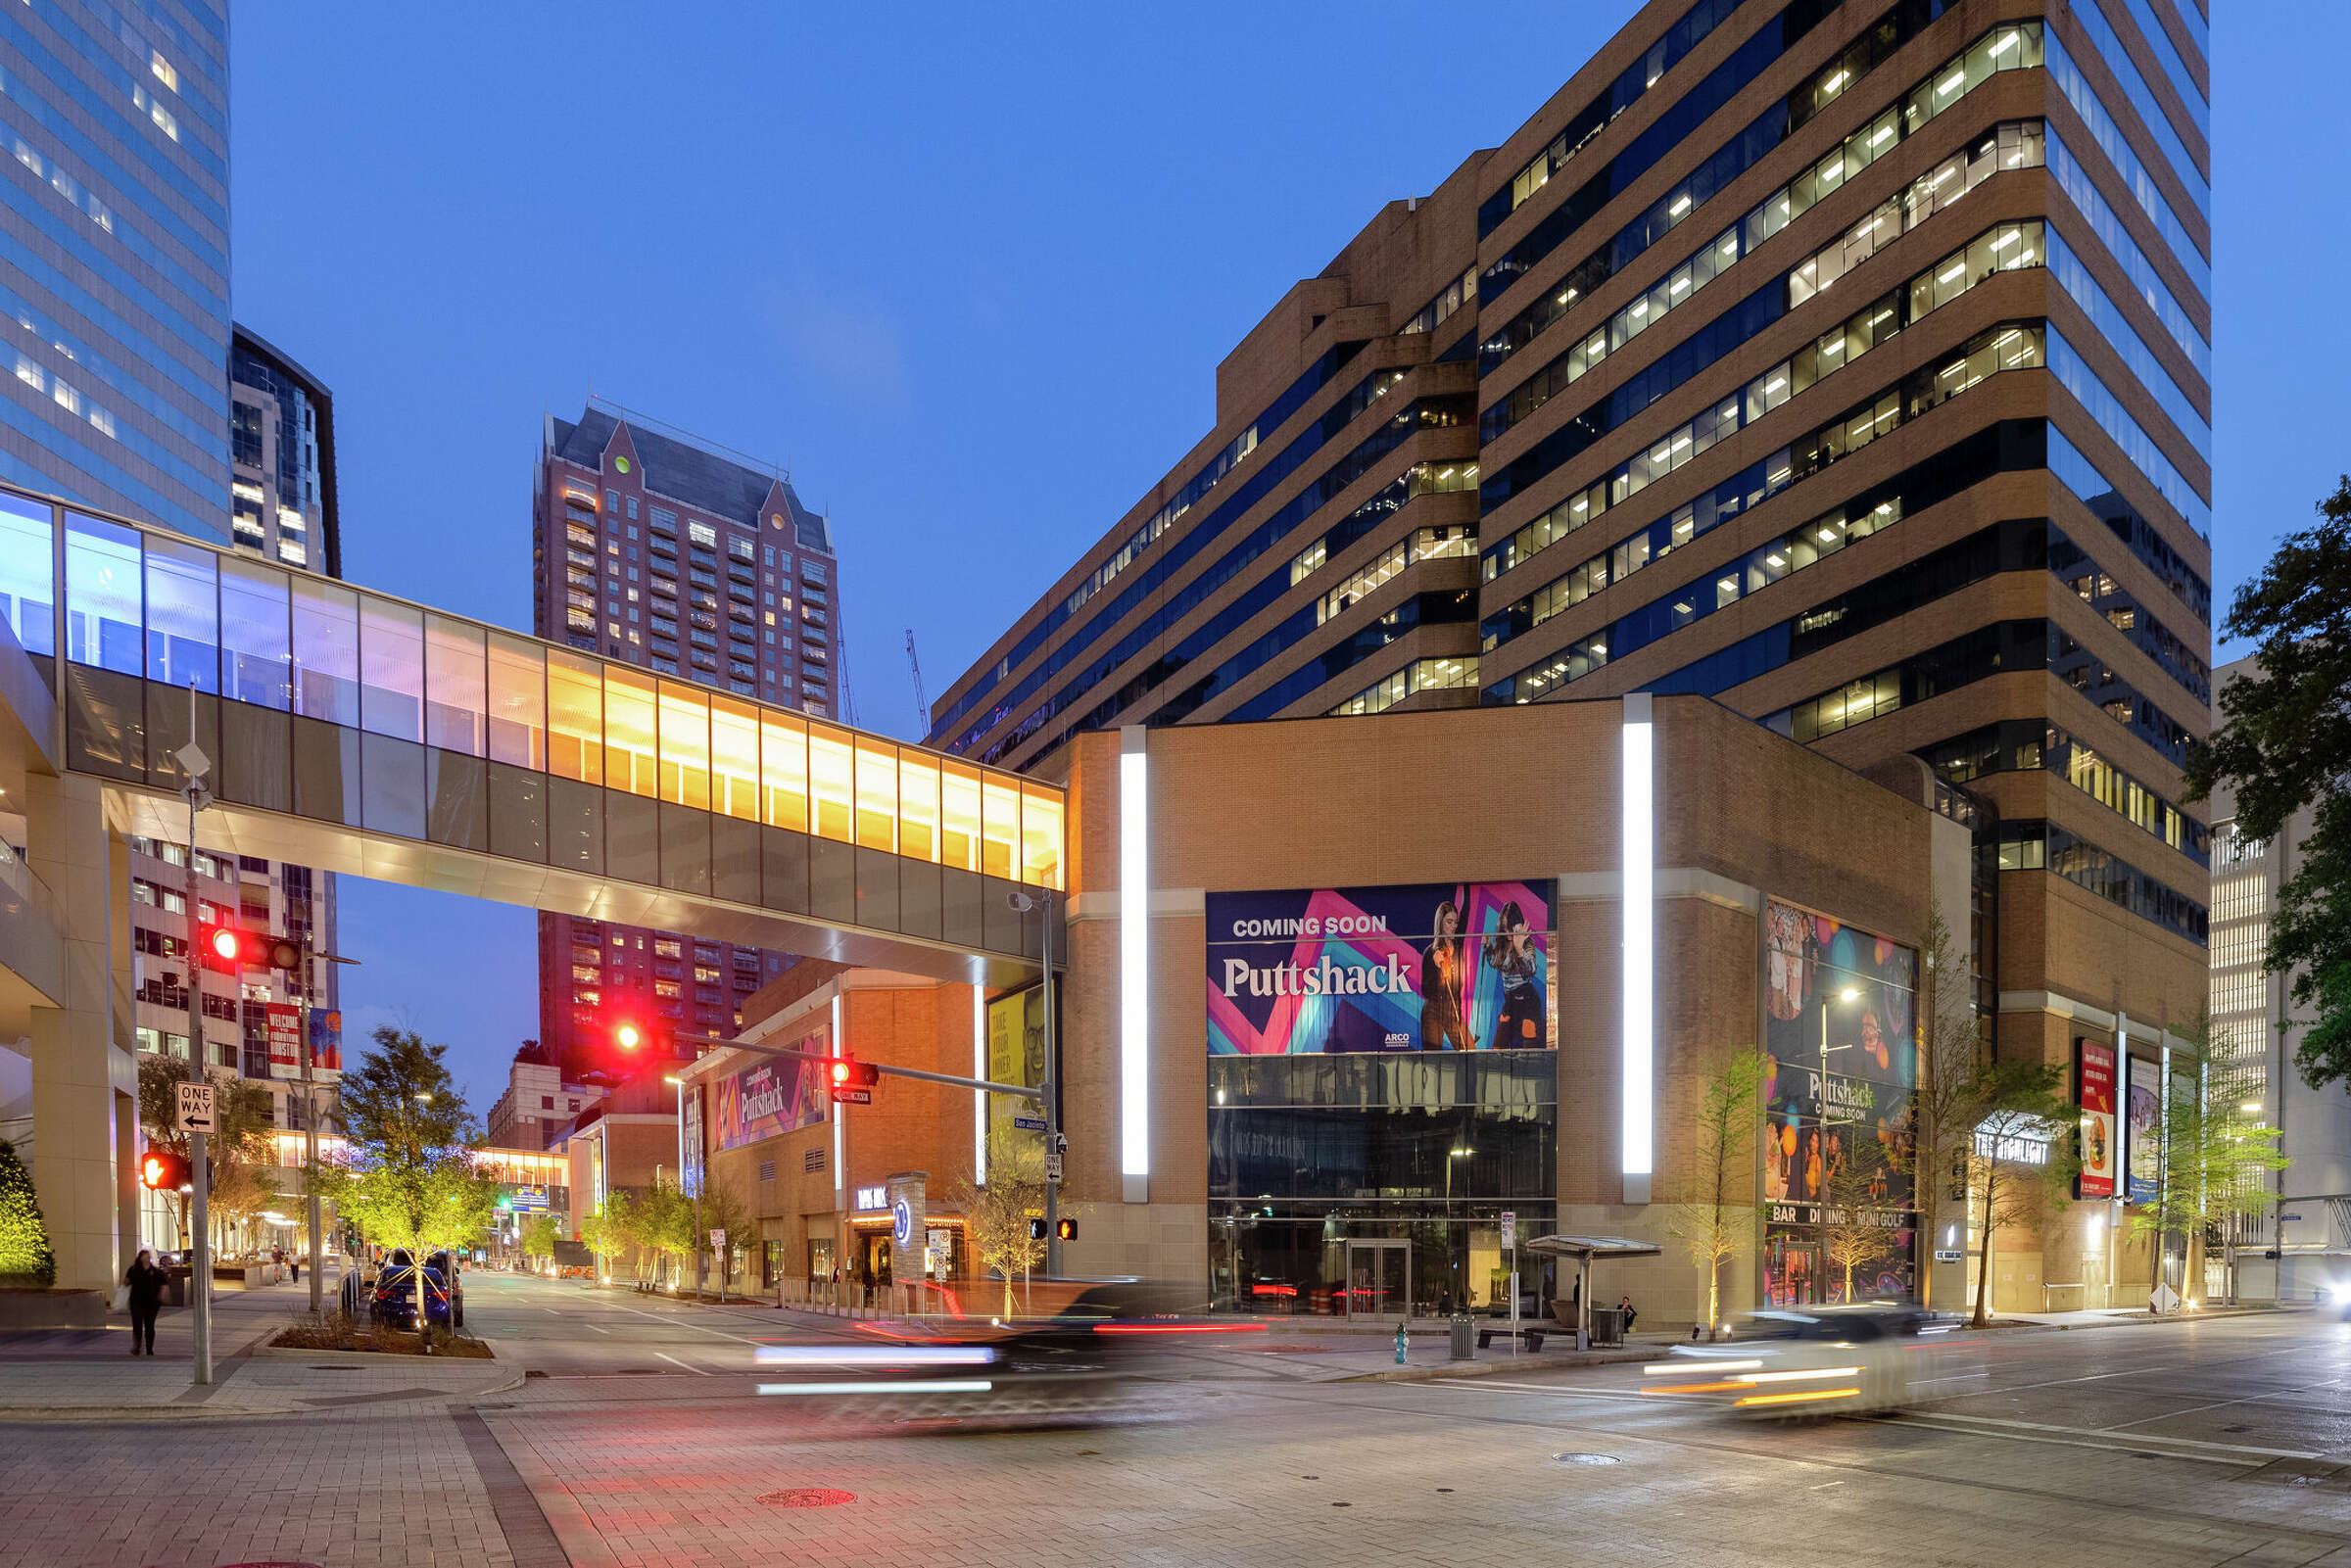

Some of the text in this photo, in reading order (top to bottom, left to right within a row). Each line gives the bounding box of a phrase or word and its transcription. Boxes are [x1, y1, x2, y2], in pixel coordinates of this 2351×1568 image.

[1232, 915, 1387, 937] COMING SOON
[1223, 952, 1413, 997] Puttshack
[269, 1013, 299, 1029] WELCOME
[1384, 1033, 1410, 1042] ARCO
[182, 1087, 211, 1101] ONE
[1808, 1072, 1874, 1110] Puttshack
[181, 1100, 211, 1114] WAY
[742, 1076, 783, 1123] Puttshack
[1815, 1103, 1866, 1120] CMING SOON
[1015, 1118, 1045, 1129] San Jacinto
[1975, 1133, 1994, 1158] THE
[1047, 1156, 1060, 1164] ONE
[1773, 1206, 1797, 1222] BAR
[1856, 1212, 1904, 1228] MINI GOLF
